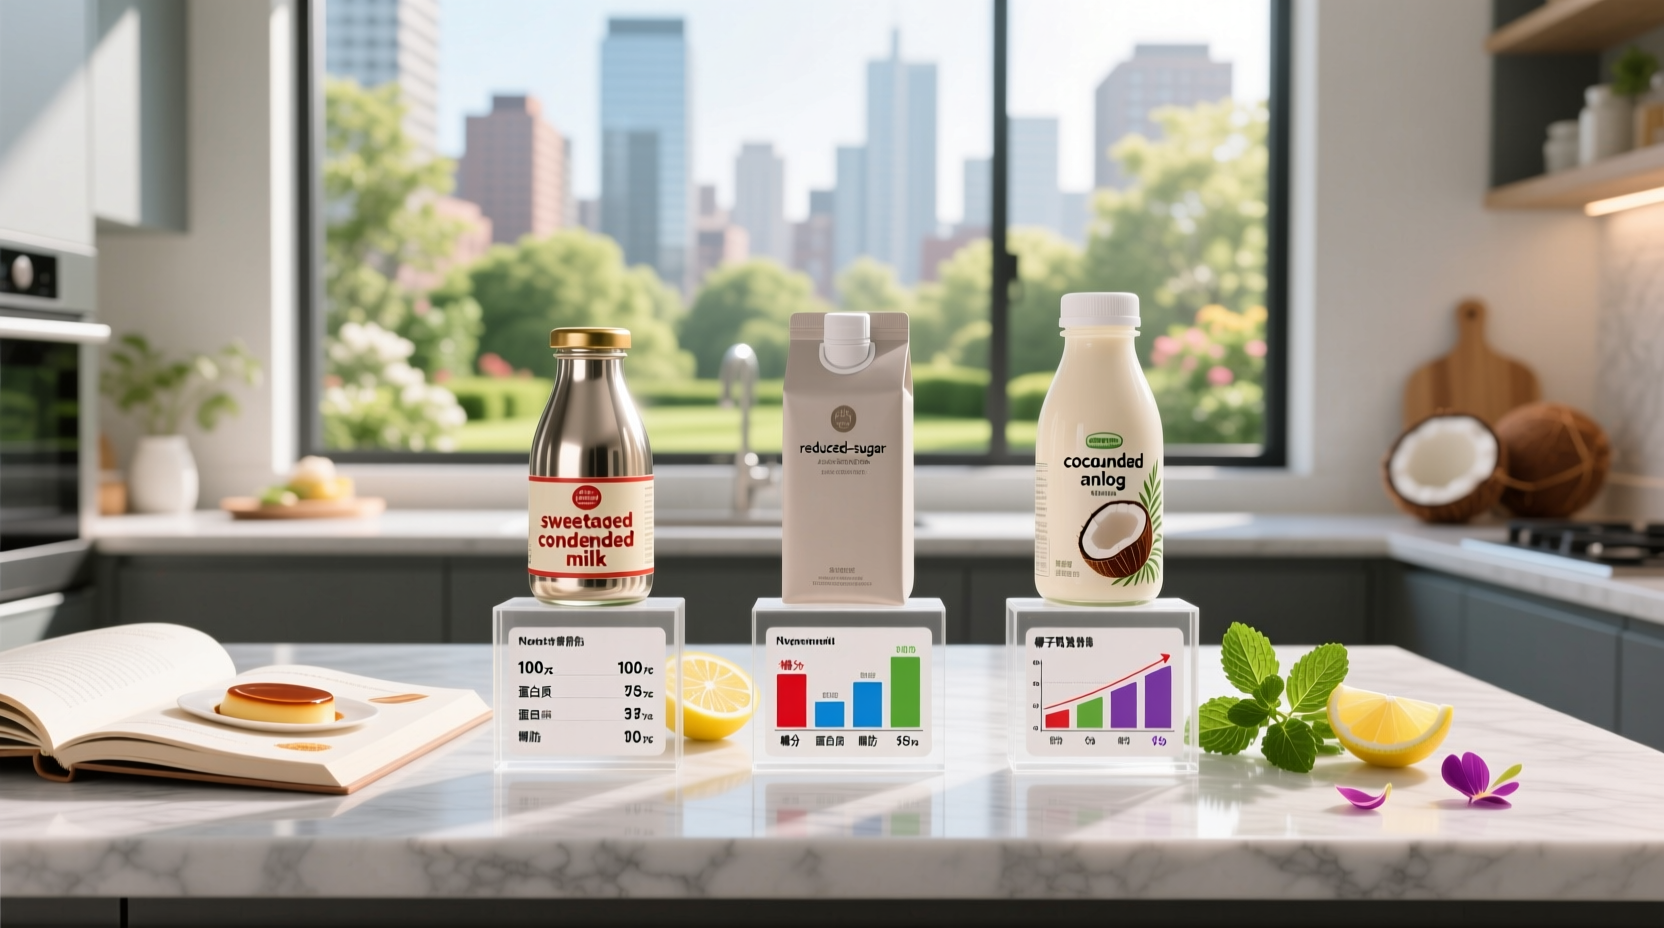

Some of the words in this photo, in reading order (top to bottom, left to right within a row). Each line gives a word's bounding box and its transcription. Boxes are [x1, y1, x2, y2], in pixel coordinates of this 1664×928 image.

[799, 440, 887, 457] reduced-sugar
[1080, 470, 1126, 491] anlog
[538, 530, 634, 548] condended
[566, 549, 607, 567] milk
